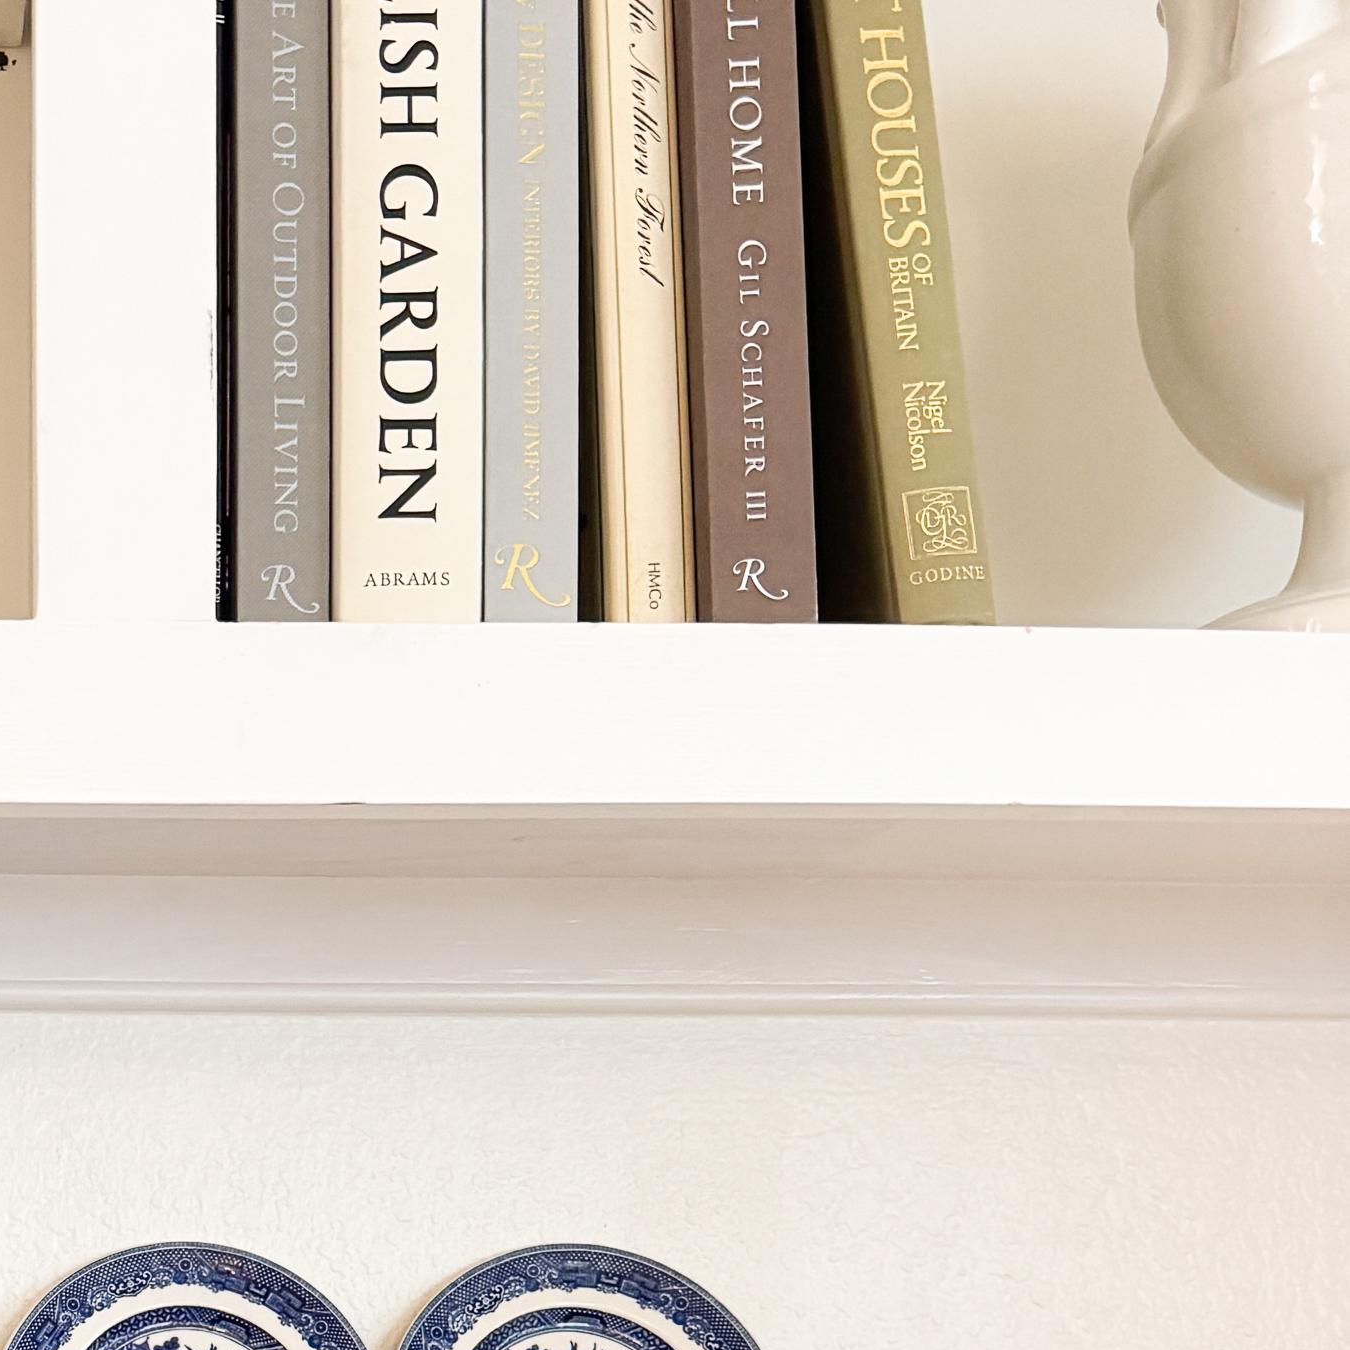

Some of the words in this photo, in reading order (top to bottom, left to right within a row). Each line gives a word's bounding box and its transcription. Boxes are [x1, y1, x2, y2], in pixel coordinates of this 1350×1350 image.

[518, 22, 546, 164] DESIGN
[629, 44, 661, 175] Northern
[273, 123, 296, 168] OF
[729, 57, 763, 205] HOME
[860, 26, 931, 247] HOUSES
[635, 188, 665, 287] Forest
[912, 252, 934, 286] OF
[524, 310, 542, 335] BY
[889, 256, 919, 350] BRITAIN
[378, 164, 438, 522] GARDEN
[523, 344, 540, 415] DAVID
[923, 380, 952, 433] Nigel
[903, 381, 931, 471] Nicolson
[746, 491, 766, 520] III
[364, 572, 449, 587] ABRAMS
[648, 563, 661, 609] HMCo
[909, 566, 985, 585] GODINE
